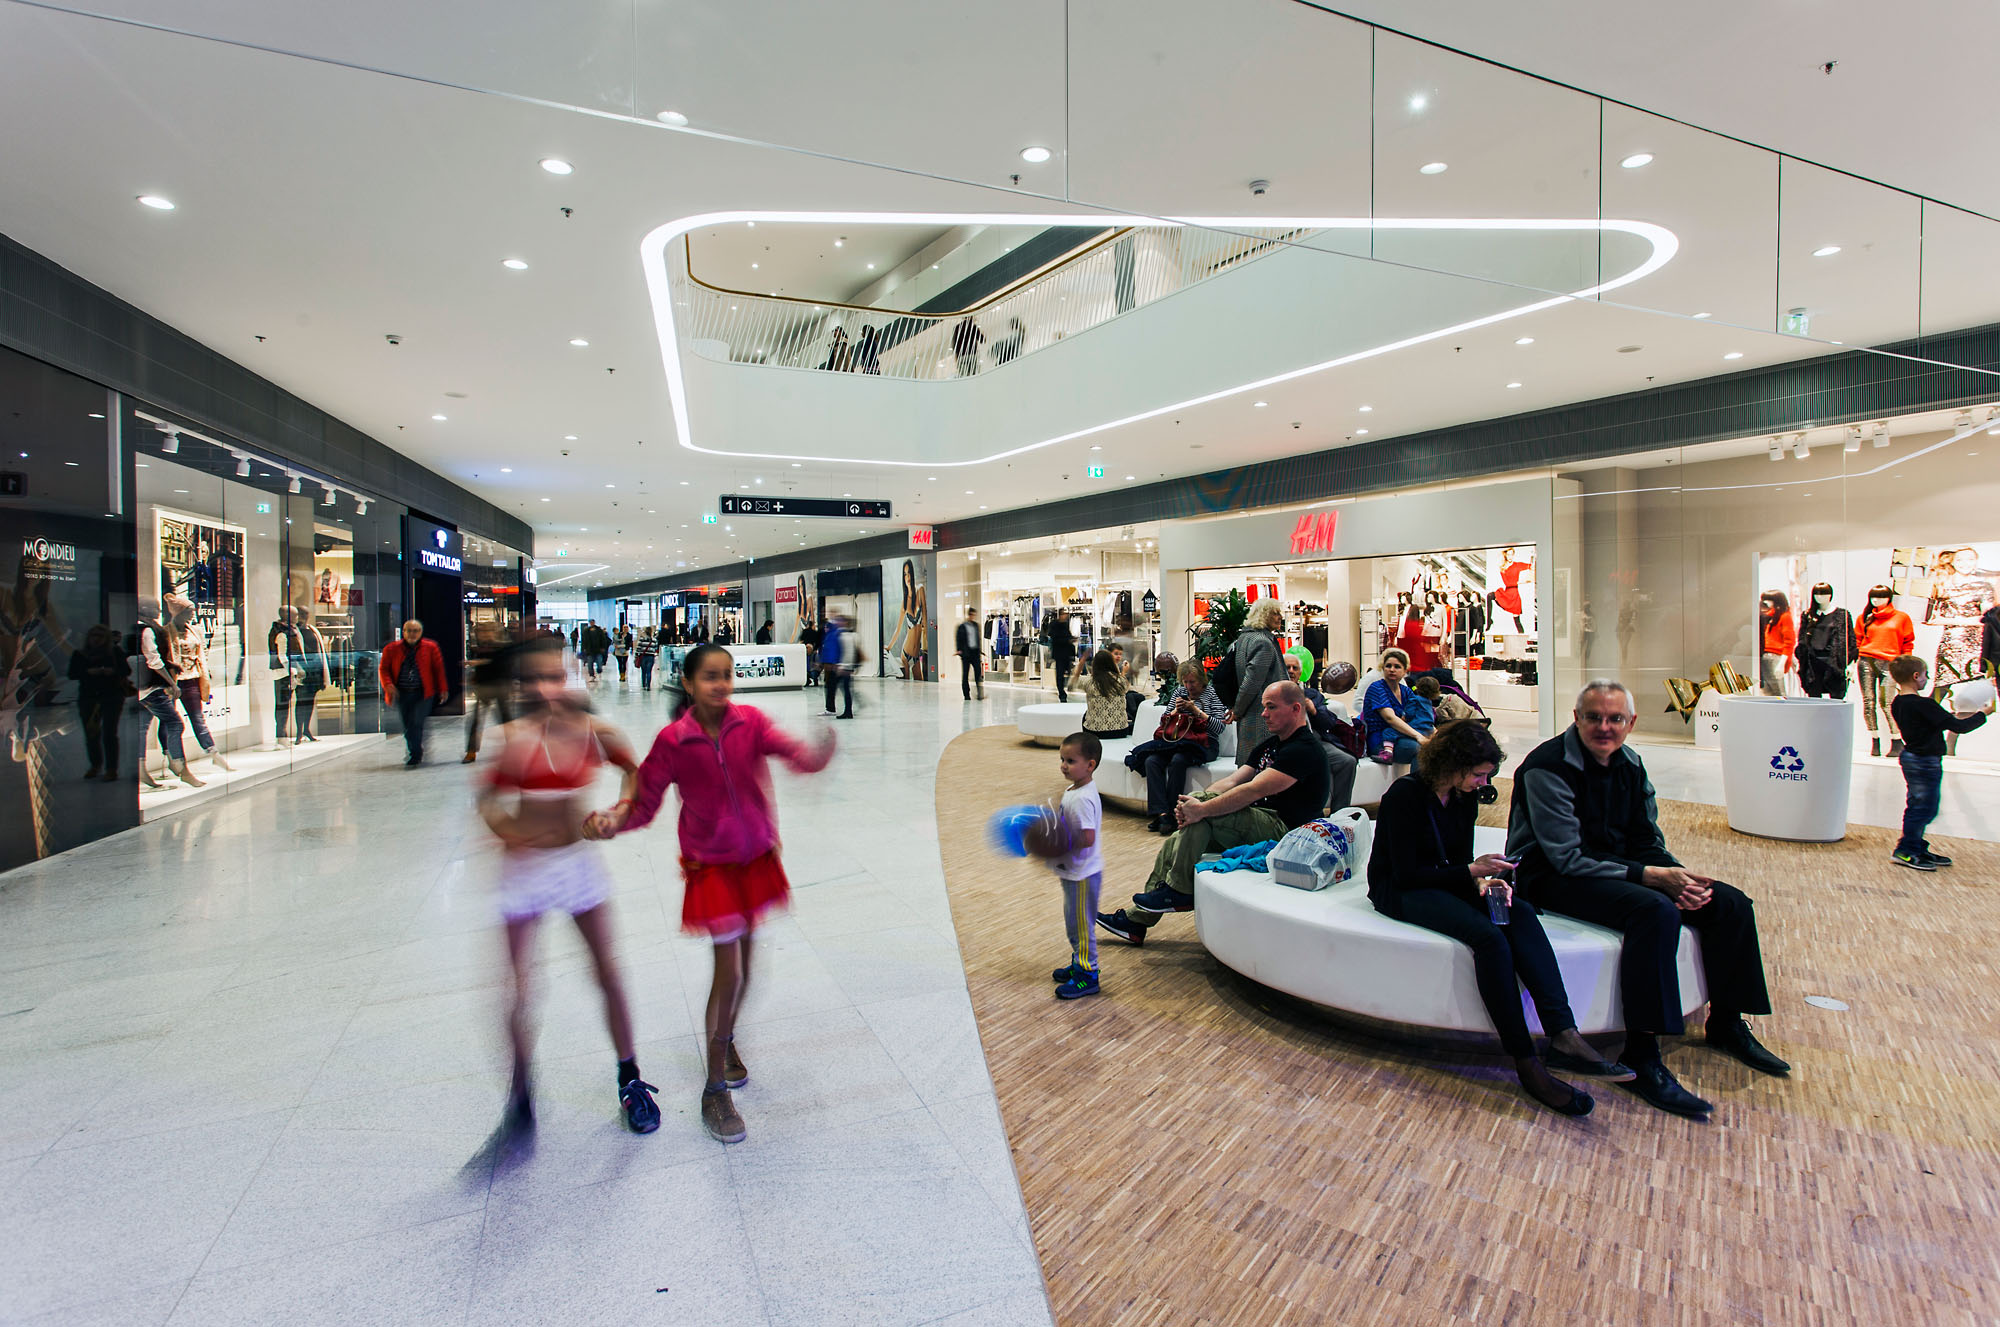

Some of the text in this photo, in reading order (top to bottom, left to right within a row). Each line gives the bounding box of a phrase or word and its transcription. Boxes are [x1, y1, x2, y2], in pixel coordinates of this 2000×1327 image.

[725, 499, 733, 511] 1
[912, 530, 931, 544] H&M
[1290, 509, 1339, 555] H&M
[23, 538, 75, 561] MONDIEU
[1768, 771, 1809, 782] PAPIER
